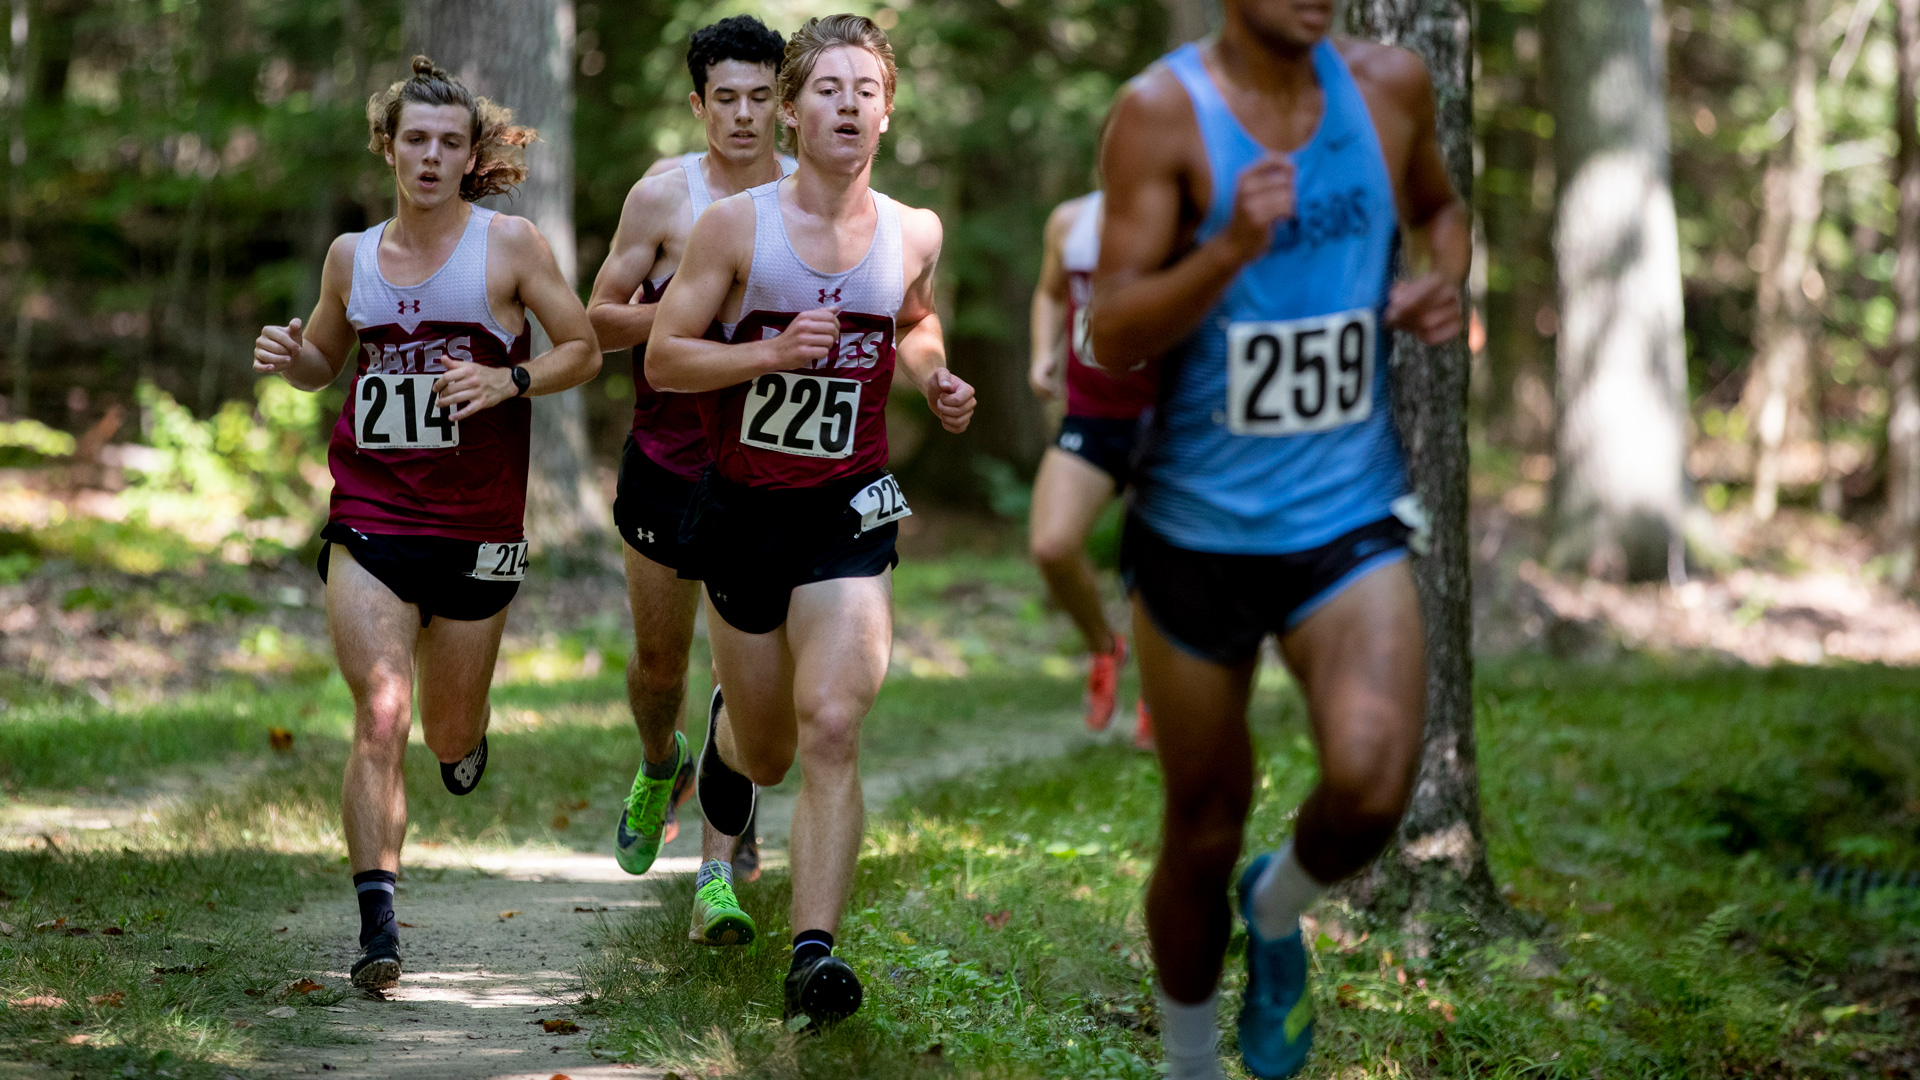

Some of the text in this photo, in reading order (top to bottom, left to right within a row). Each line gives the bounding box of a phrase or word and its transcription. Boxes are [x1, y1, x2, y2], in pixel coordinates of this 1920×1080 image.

[362, 336, 473, 375] BATES
[1245, 321, 1364, 421] 259
[362, 376, 455, 443] 214
[747, 374, 856, 453] 225
[491, 543, 529, 576] 214
